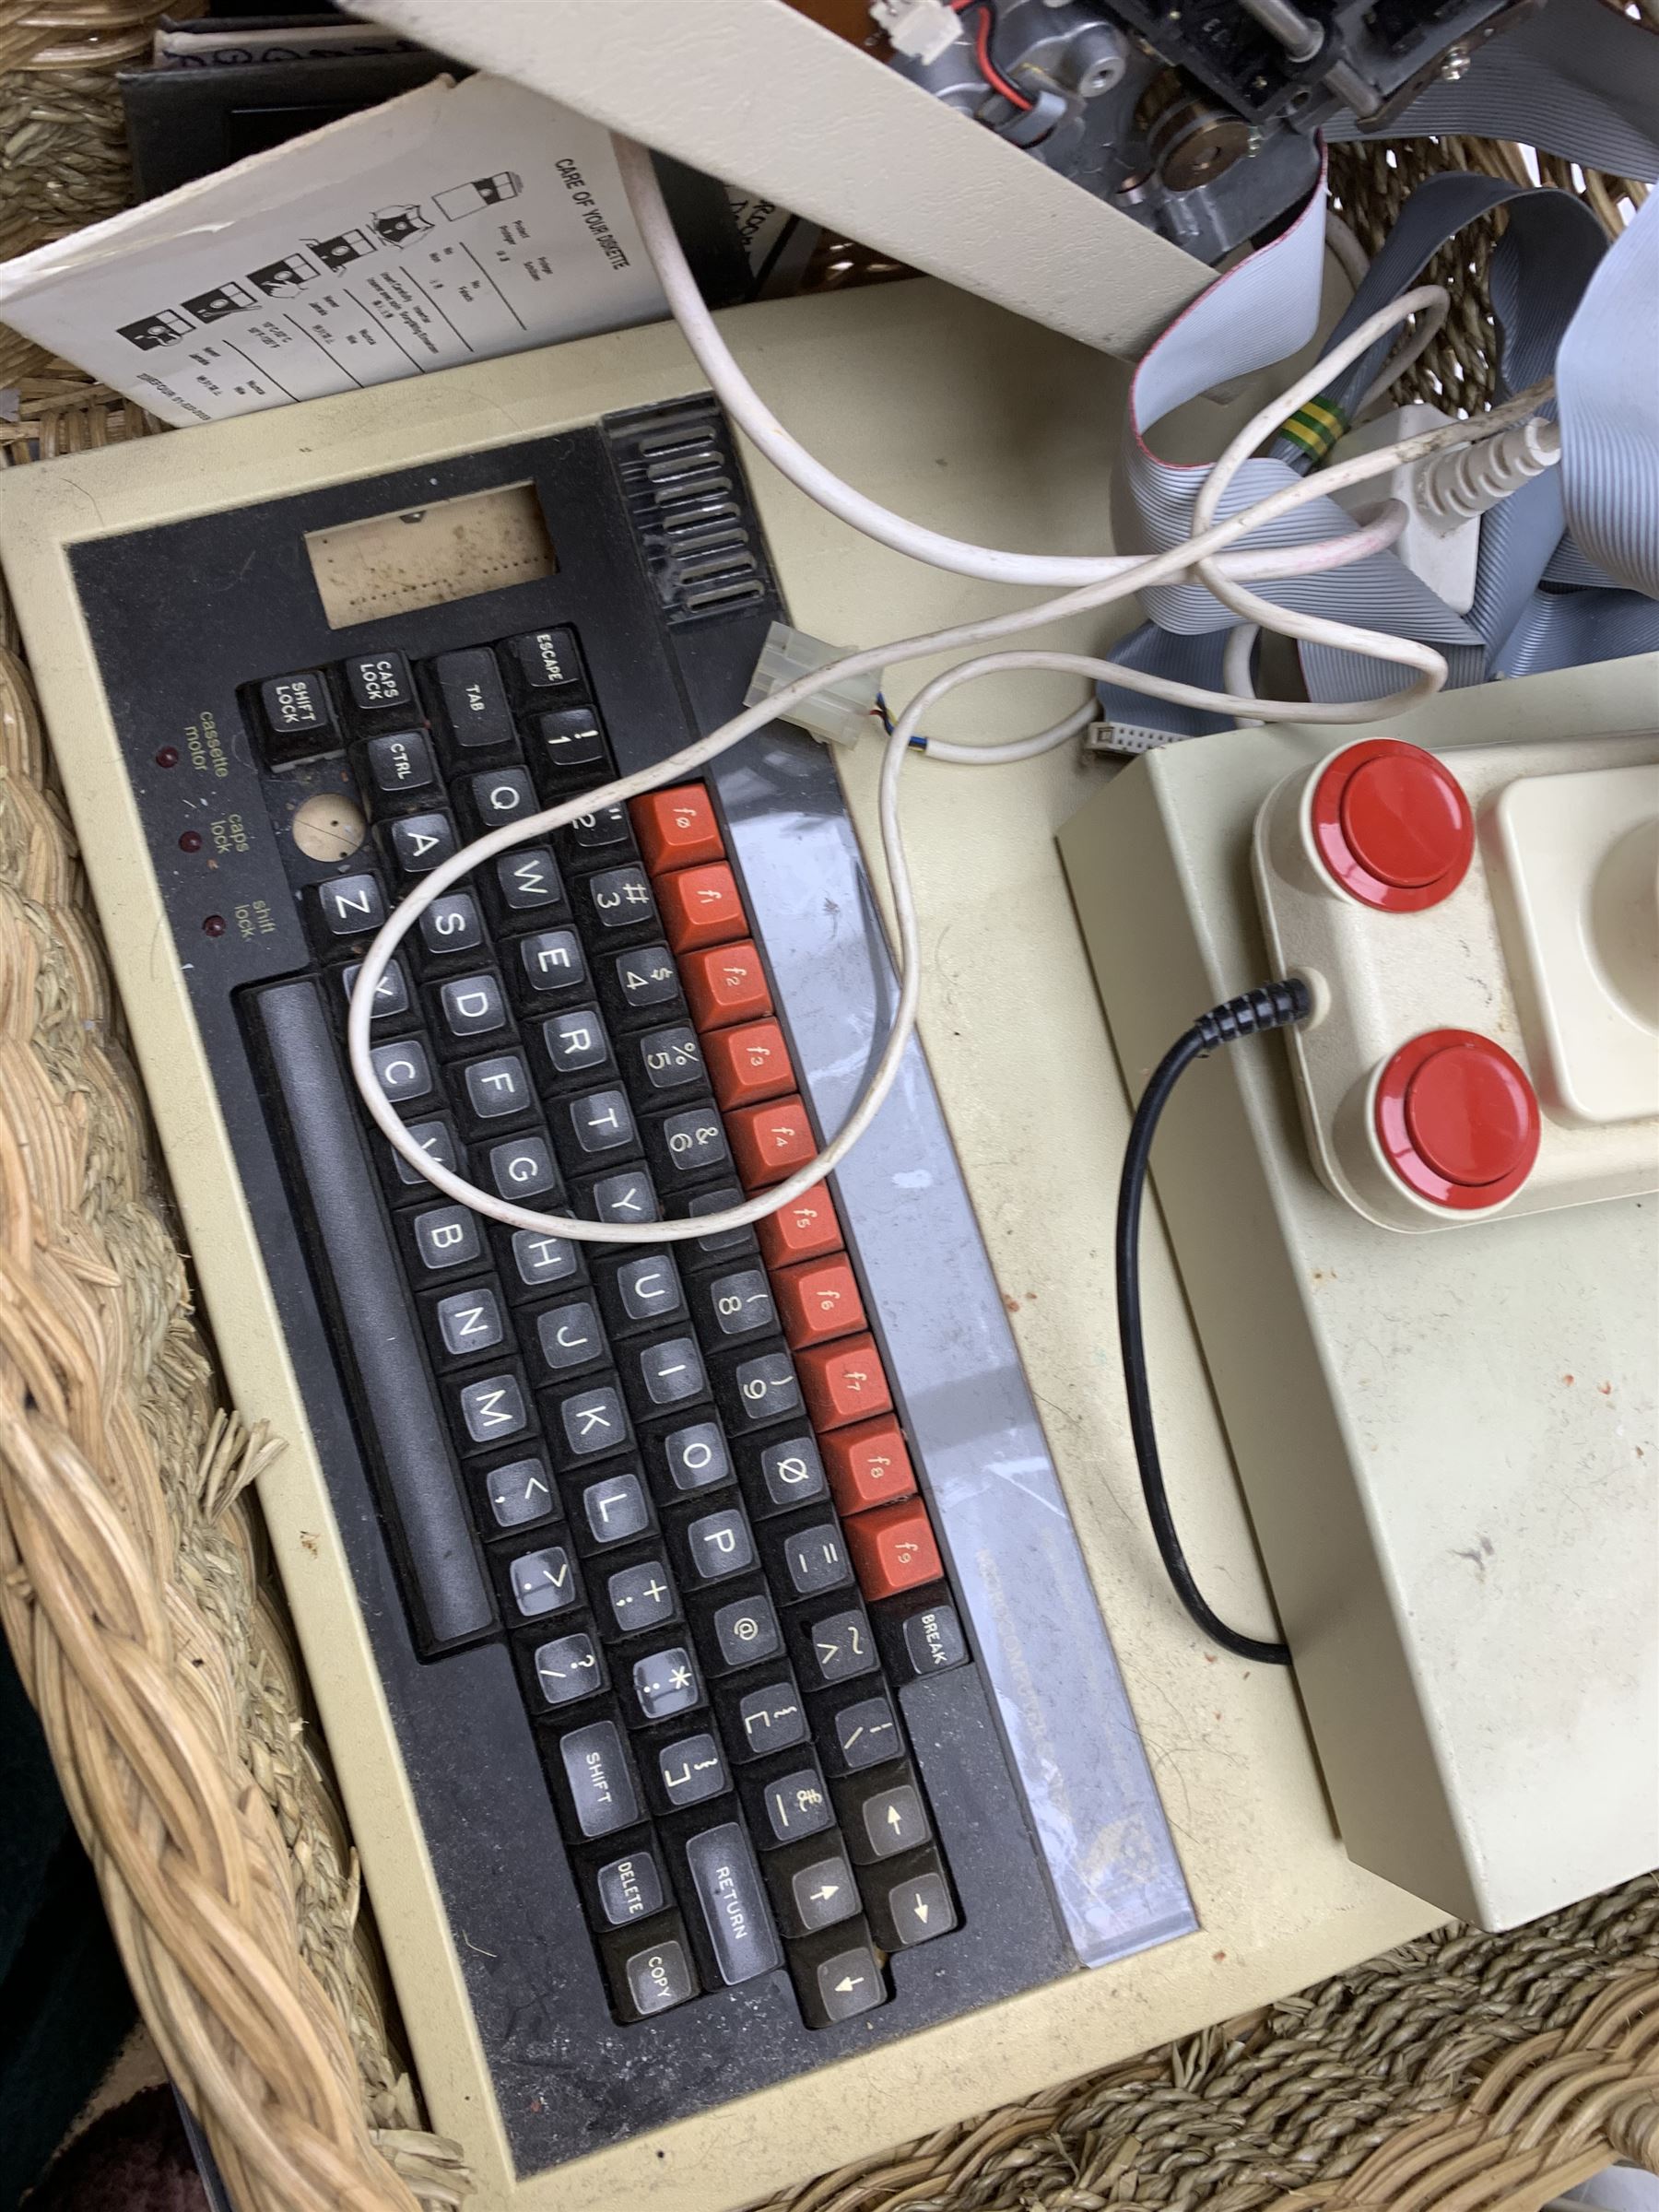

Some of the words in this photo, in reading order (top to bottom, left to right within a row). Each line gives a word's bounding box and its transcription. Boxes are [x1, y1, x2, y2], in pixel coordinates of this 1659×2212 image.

[555, 159, 584, 189] CARE
[572, 192, 594, 206] OF
[582, 209, 609, 235] YOUR
[596, 235, 630, 270] DISKETTE
[536, 634, 564, 681] ESCAPE
[359, 664, 385, 700] LOCK
[376, 661, 400, 699] CAPS
[276, 686, 300, 724] LOCK
[291, 681, 316, 721] SHIFT
[465, 684, 486, 712] TAB
[183, 725, 208, 771] motor
[200, 711, 229, 778] cassette
[547, 735, 572, 745] 1
[390, 743, 413, 781] CTRL
[490, 785, 521, 810] Q
[210, 820, 230, 855] lock
[229, 813, 250, 853] caps
[406, 831, 440, 857] A
[513, 859, 548, 895] W
[334, 889, 371, 919] Z
[596, 891, 621, 909] 3
[622, 883, 650, 904] #
[234, 904, 254, 938] lock
[252, 900, 276, 935] shift
[434, 912, 466, 936] S
[537, 947, 571, 972] E
[626, 970, 650, 991] 4
[723, 966, 748, 987] f2
[456, 992, 488, 1018] D
[559, 1029, 592, 1055] R
[671, 1042, 700, 1066] %
[647, 1052, 672, 1070] 5
[746, 1046, 771, 1067] f3
[384, 1060, 416, 1085] C
[480, 1072, 515, 1094] F
[588, 1108, 619, 1129] T
[669, 1133, 693, 1153] 6
[695, 1126, 719, 1146] &
[771, 1126, 795, 1147] f4
[509, 1157, 539, 1182] G
[611, 1187, 642, 1212] Y
[793, 1208, 818, 1229] f5
[430, 1223, 463, 1249] B
[527, 1238, 562, 1268] H
[634, 1273, 666, 1299] U
[718, 1296, 742, 1315] 8
[816, 1289, 841, 1311] f6
[454, 1306, 489, 1336] N
[556, 1325, 588, 1347] J
[743, 1379, 768, 1400] 9
[842, 1371, 868, 1392] f7
[475, 1389, 513, 1428] M
[575, 1406, 611, 1436] K
[682, 1442, 712, 1469] O
[867, 1456, 891, 1479] f8
[599, 1493, 628, 1523] L
[703, 1528, 735, 1553] P
[895, 1541, 919, 1564] f9
[642, 1579, 667, 1603] +
[733, 1617, 759, 1641] @
[921, 1613, 948, 1665] BREAK
[570, 1653, 595, 1670] ?
[585, 1751, 613, 1804] SHIFT
[795, 1788, 823, 1813] £
[618, 1862, 644, 1915] DELETE
[715, 1865, 748, 1940] RETURN
[647, 1956, 671, 1998] COPY
